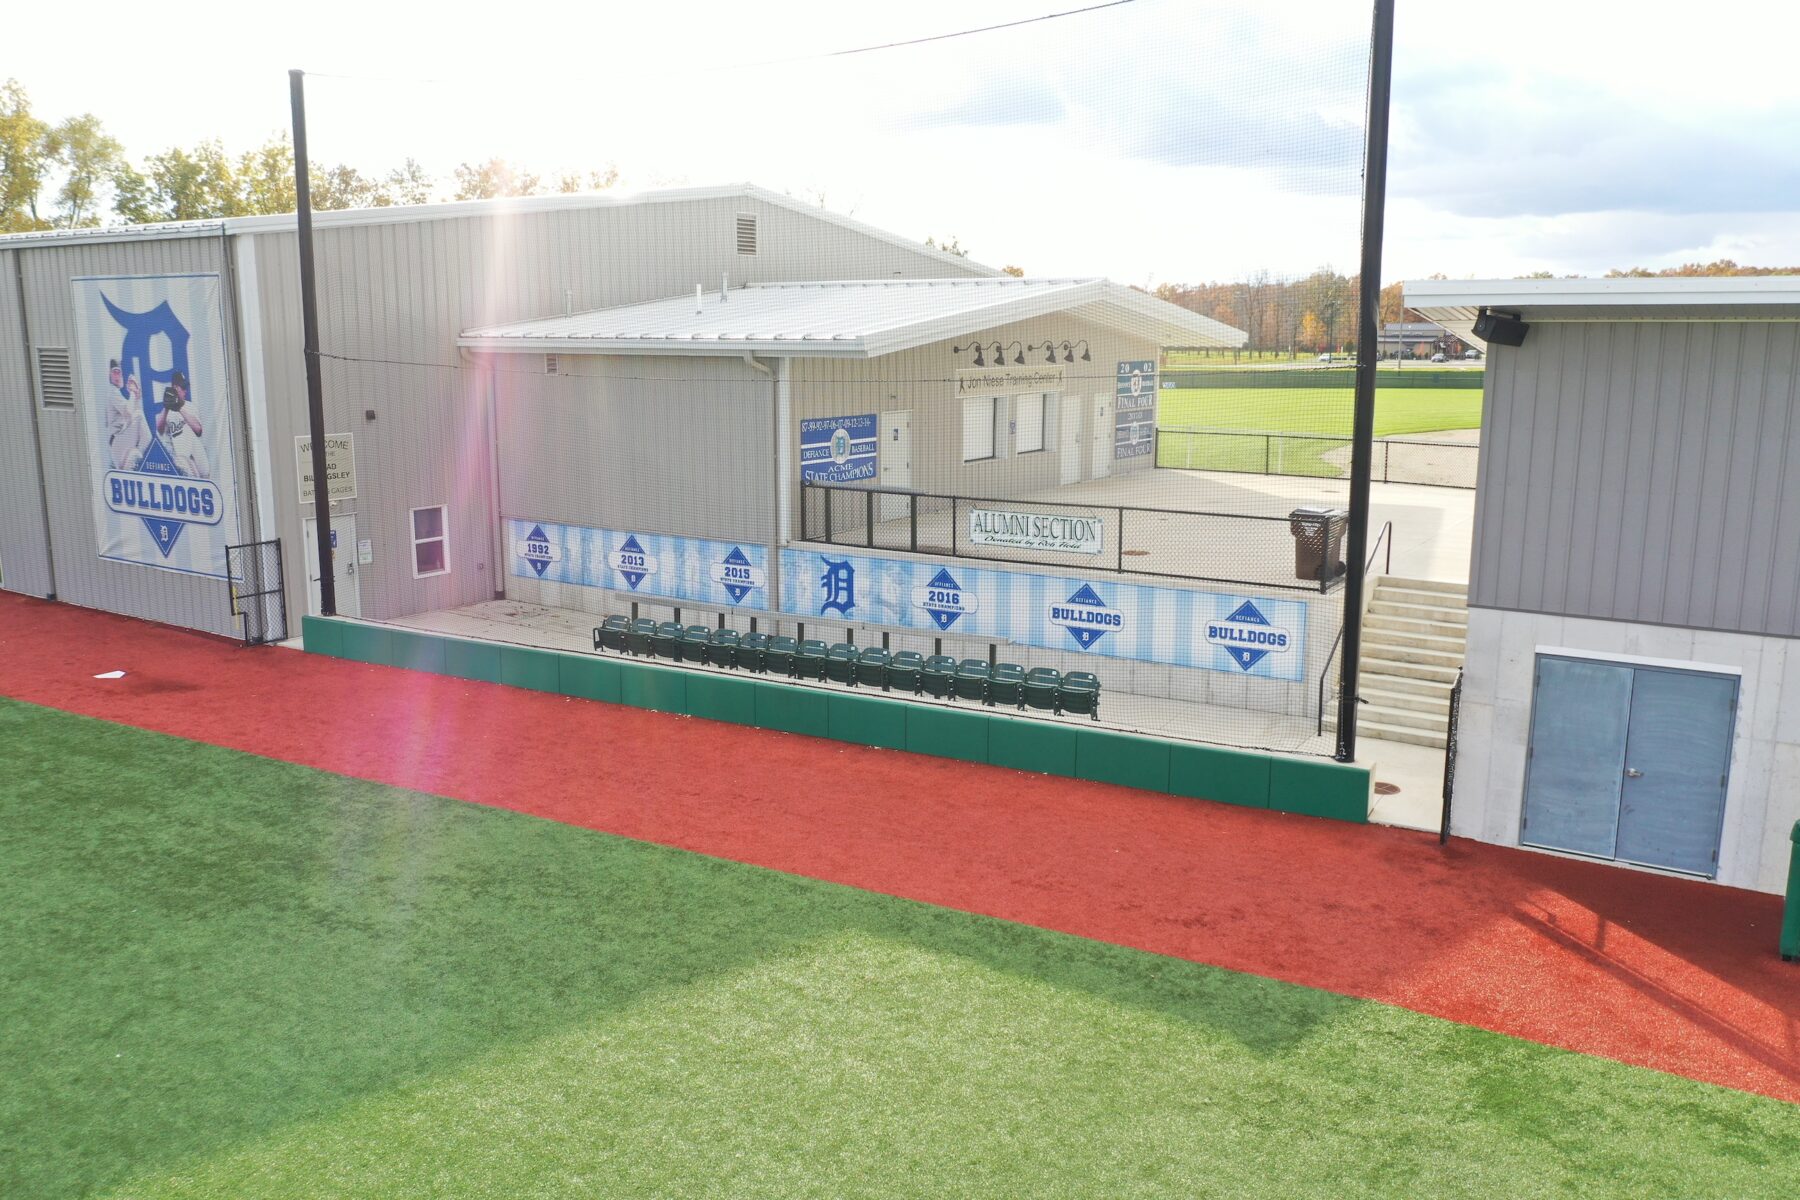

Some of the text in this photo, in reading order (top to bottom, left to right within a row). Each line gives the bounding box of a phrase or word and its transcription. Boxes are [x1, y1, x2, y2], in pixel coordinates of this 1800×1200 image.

[1120, 362, 1152, 373] 20 02
[1117, 394, 1153, 409] FINAL FOUR
[851, 443, 875, 454] BASEBALL
[1116, 443, 1151, 458] FINAL FOUR
[145, 461, 171, 472] DEFIANCE
[805, 462, 874, 484] STATE CHAMPIONS
[828, 463, 854, 473] ACME
[110, 477, 215, 516] BULLDOGS
[974, 511, 1097, 542] ALUMNI SECTION
[527, 543, 550, 555] 1992
[1024, 539, 1036, 547] by
[621, 554, 645, 567] 2013
[724, 566, 750, 579] 2015
[820, 554, 856, 616] D
[928, 590, 960, 605] 2016
[1052, 607, 1121, 626] BULLDOGS
[1208, 625, 1287, 646] BULLDOGS
